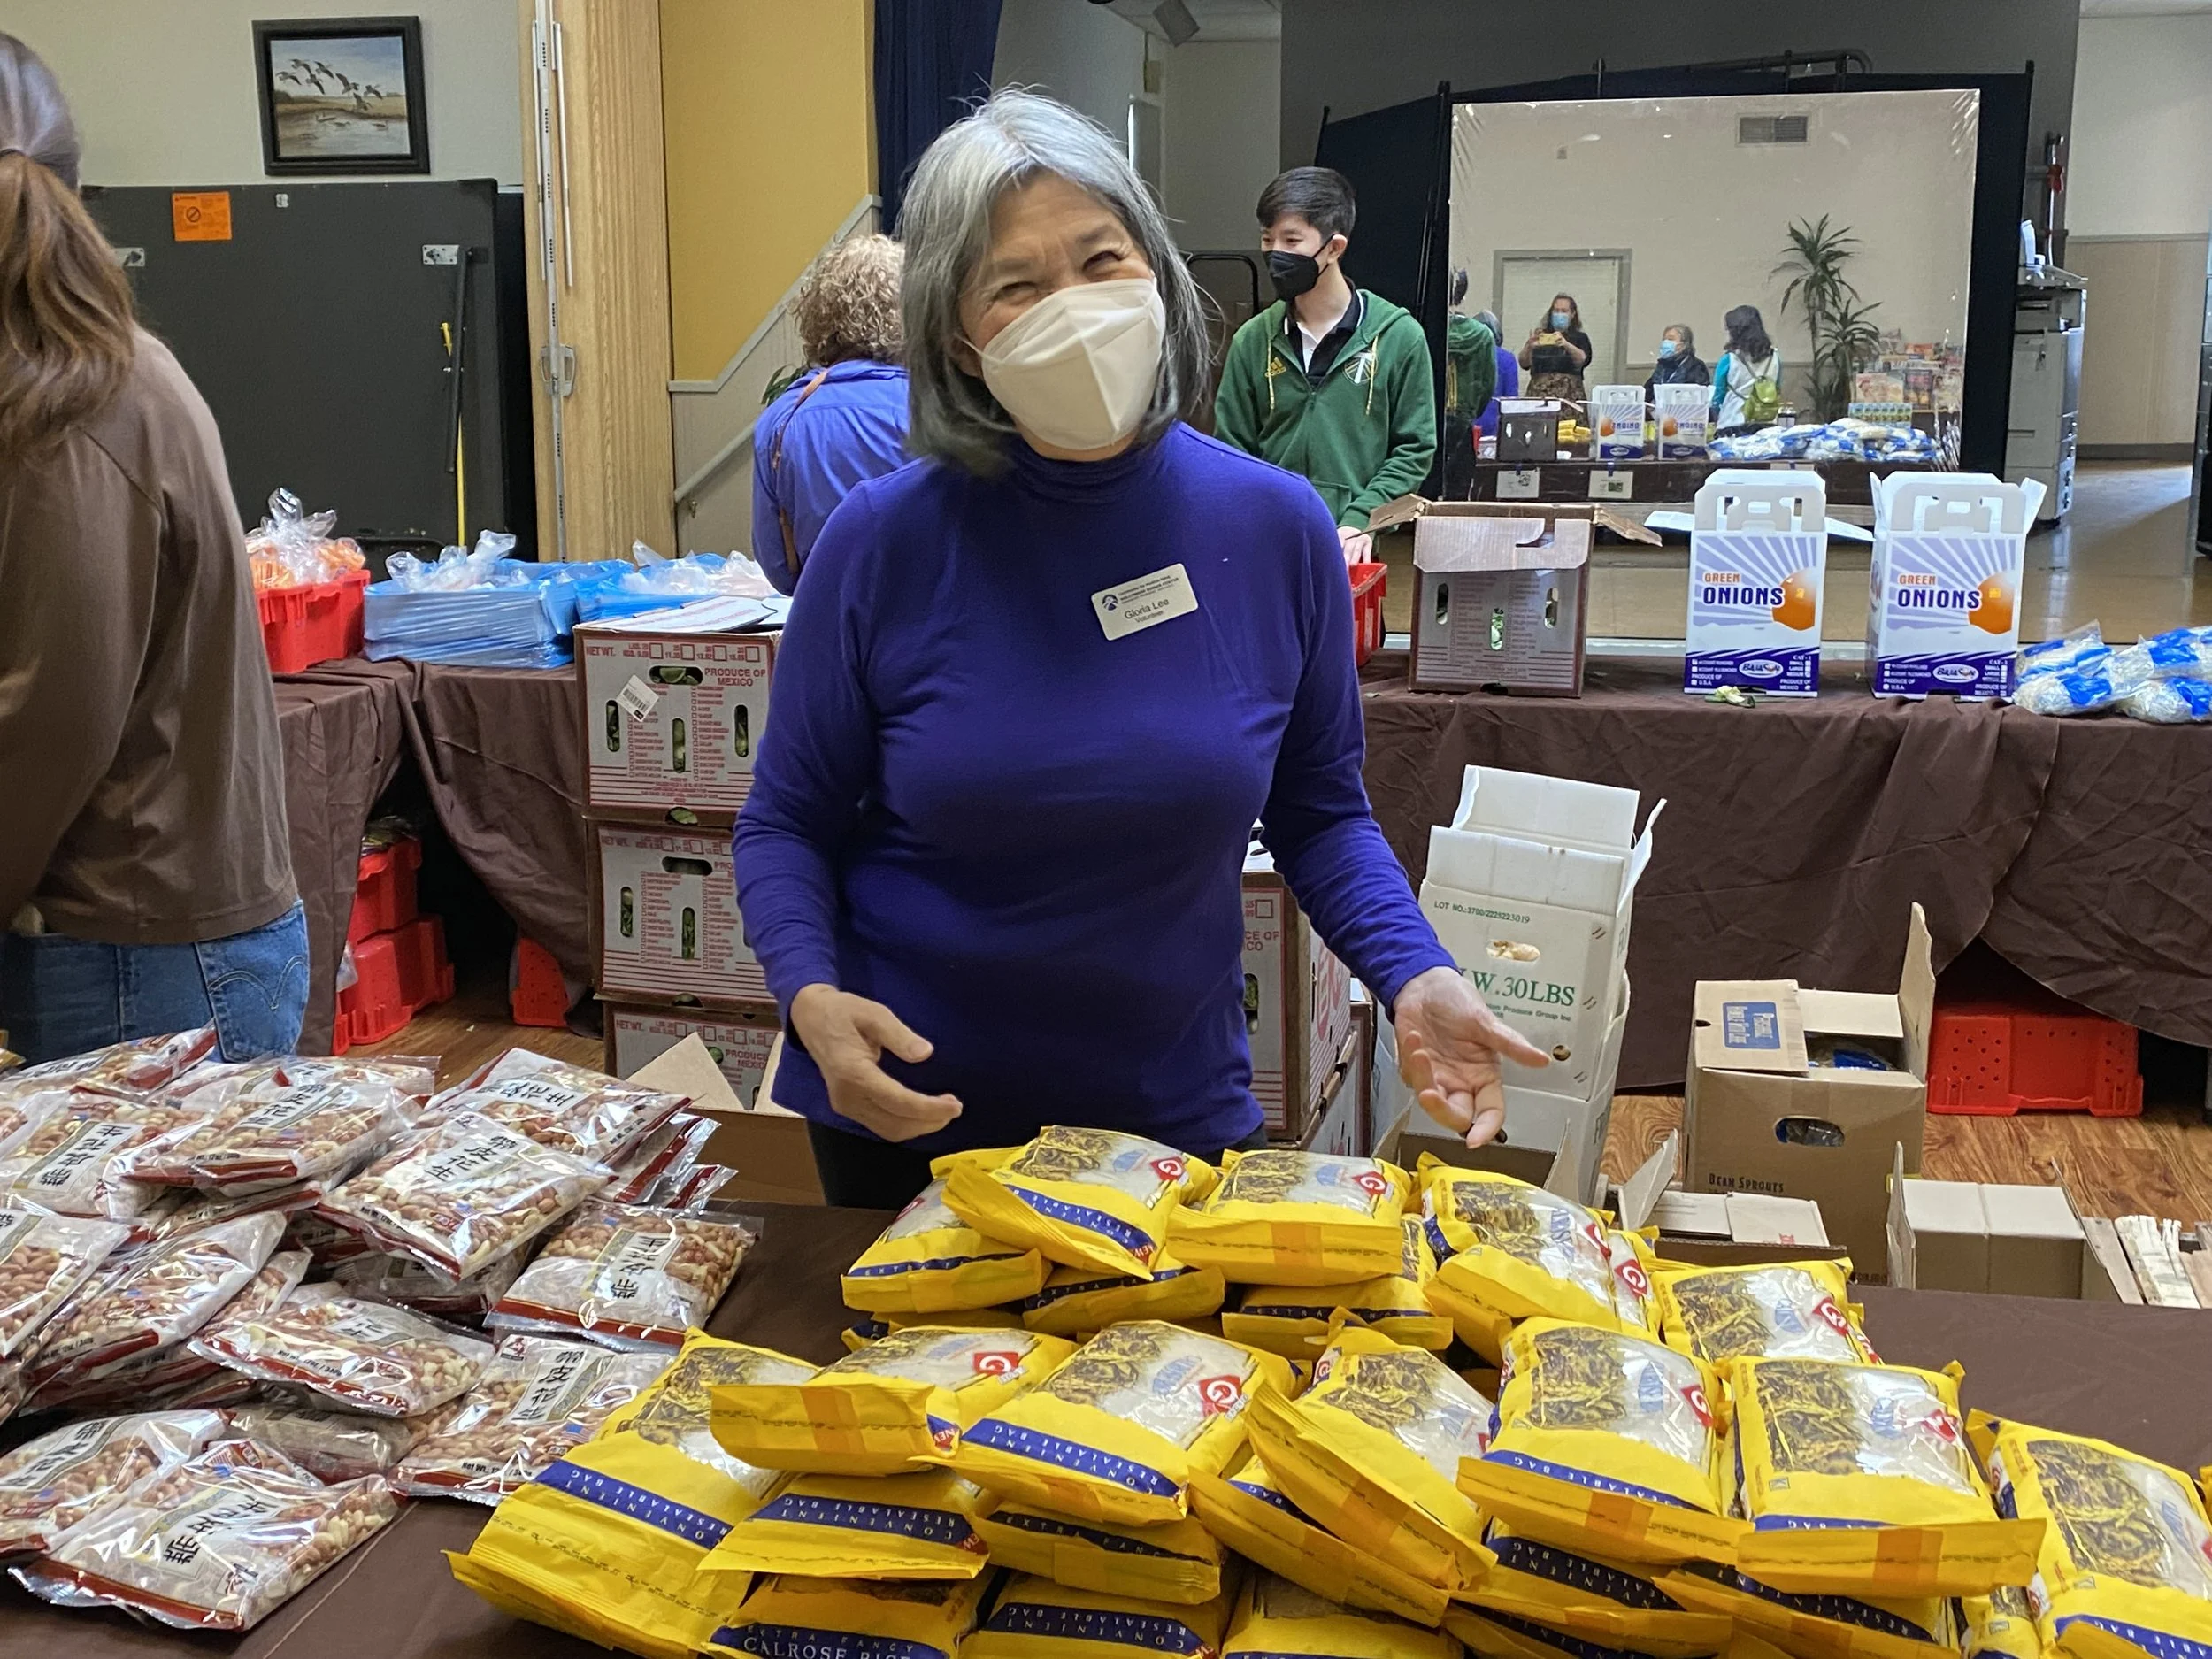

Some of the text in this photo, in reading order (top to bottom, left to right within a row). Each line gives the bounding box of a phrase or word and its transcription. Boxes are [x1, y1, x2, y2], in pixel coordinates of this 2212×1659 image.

[1705, 573, 1740, 582] GREEN
[1900, 575, 1936, 585] GREEN
[1704, 587, 1783, 605] ONIONS
[1898, 589, 1980, 609] ONIONS
[1125, 598, 1170, 620] Gloria Lee
[704, 668, 750, 677] PRODUCE
[1434, 901, 1449, 910] LOT
[1263, 931, 1279, 941] OF
[994, 1425, 1159, 1486] RESEALABLE BAG
[1514, 1456, 1550, 1474] BAG
[565, 1480, 705, 1540] ONVENIENT
[571, 1470, 727, 1535] RESEALABLE BAG
[784, 1497, 956, 1528] RESEALABLE BAG
[781, 1509, 953, 1540] CONVENIENT
[1514, 1542, 1668, 1603] SEALABLE BAG
[1008, 1607, 1187, 1636] RESEALABLE BAG
[841, 1637, 913, 1653] FANCY
[1006, 1619, 1185, 1650] CONVENIENT
